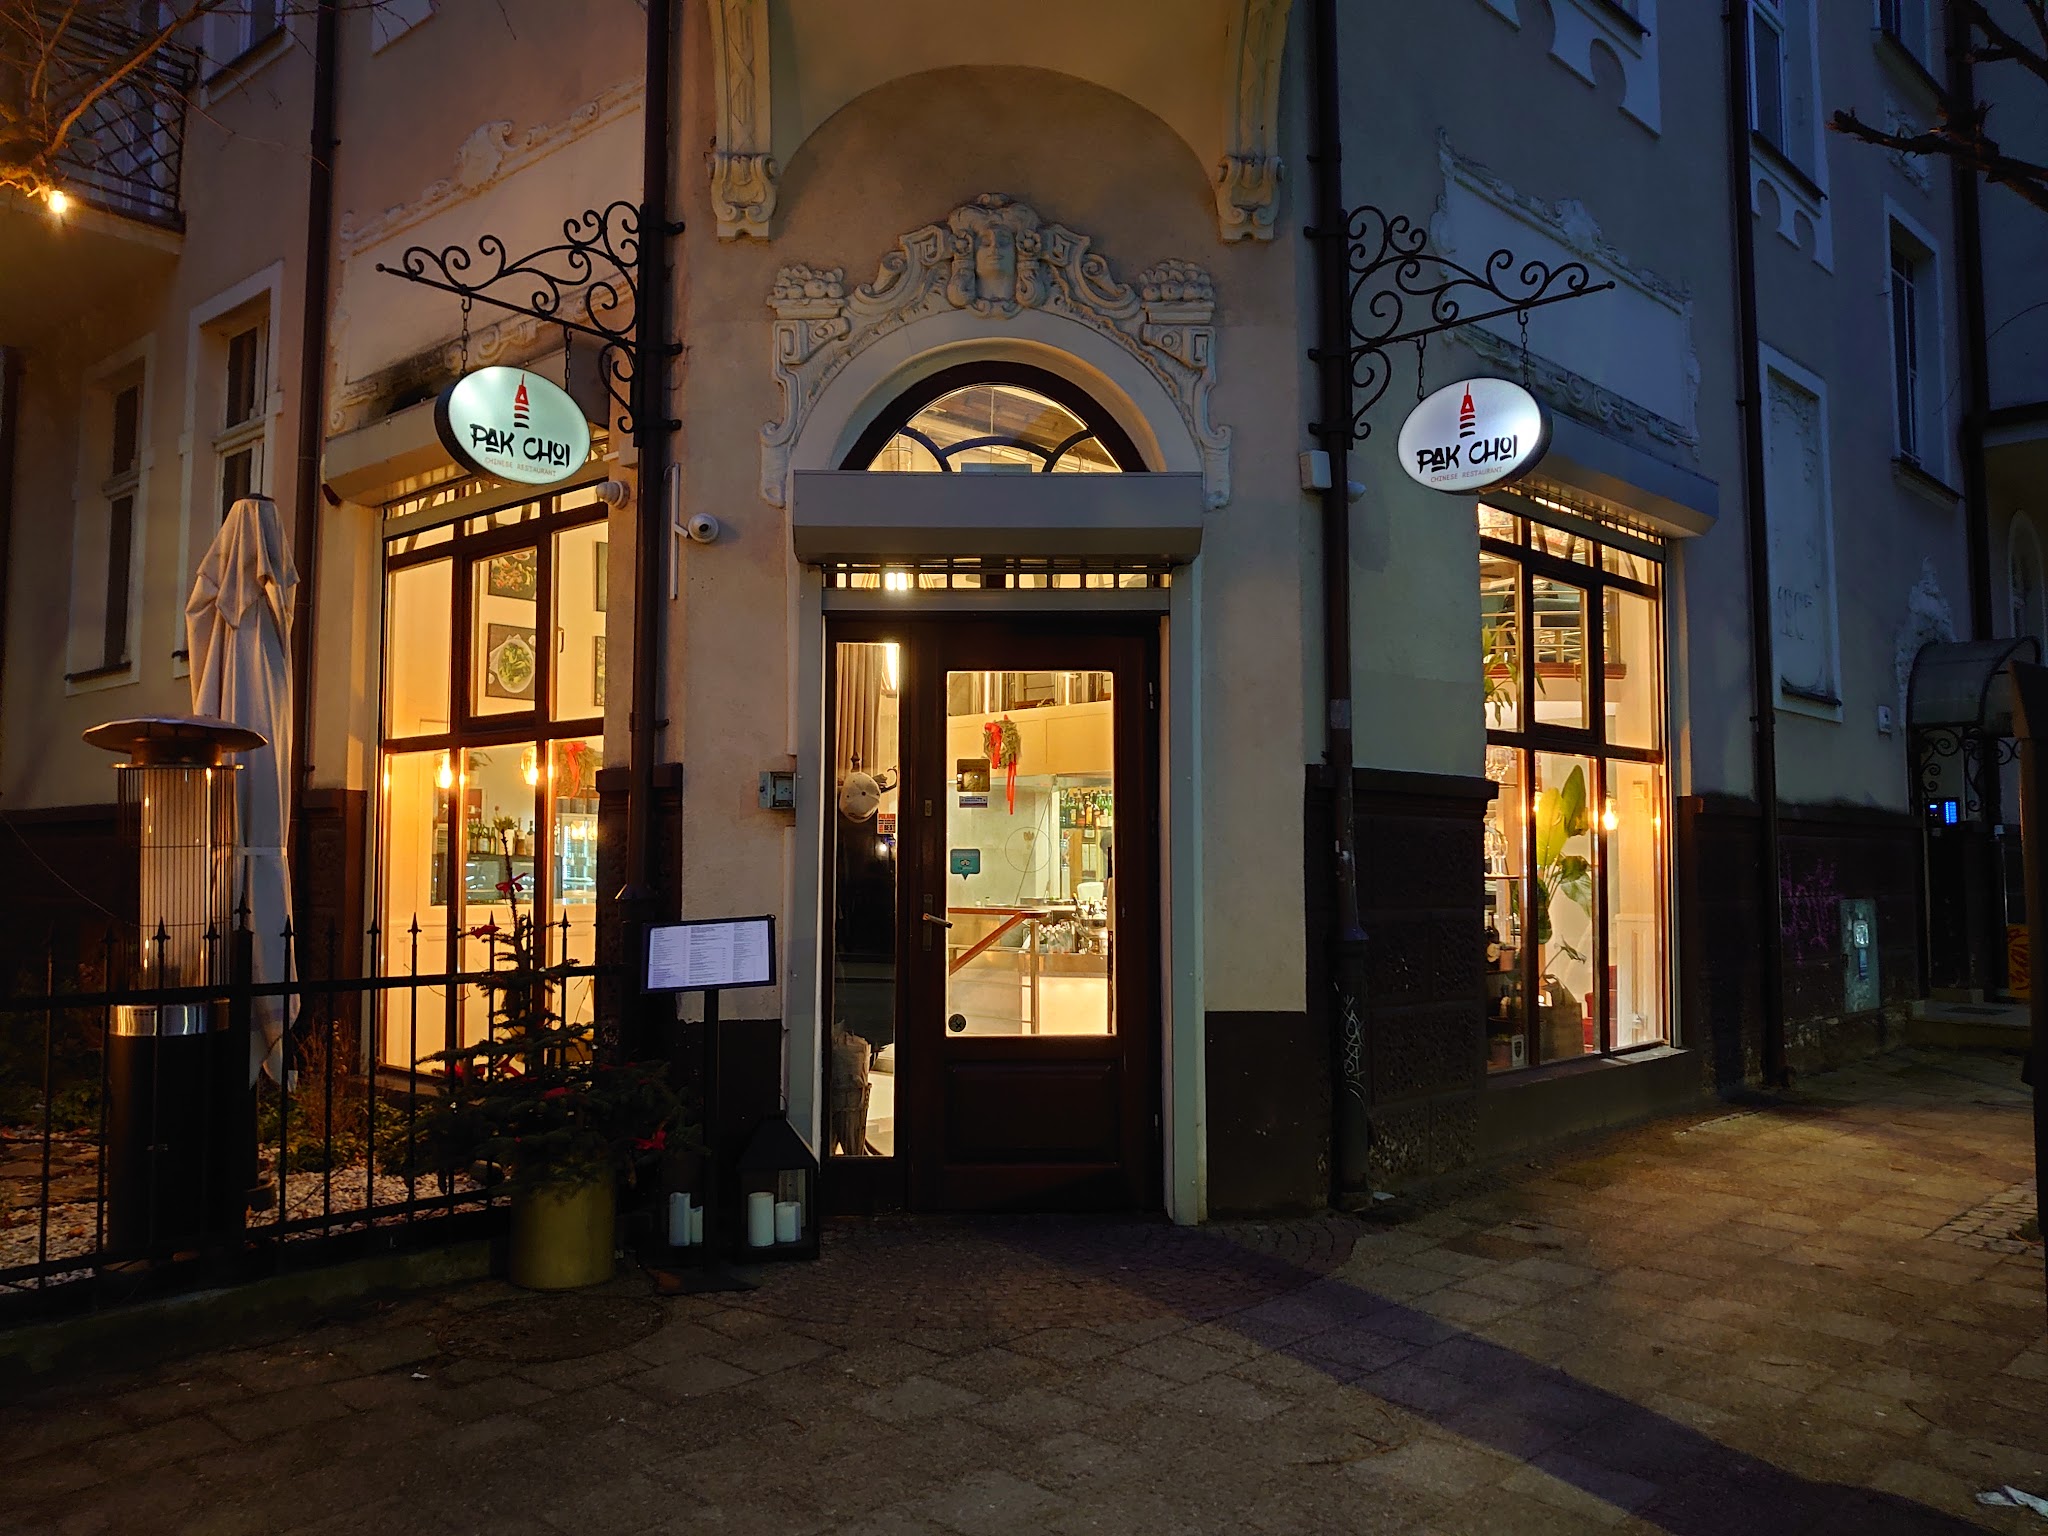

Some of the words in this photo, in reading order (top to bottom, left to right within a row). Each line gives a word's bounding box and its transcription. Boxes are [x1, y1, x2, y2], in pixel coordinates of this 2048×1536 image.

[470, 424, 514, 457] PAK
[523, 437, 570, 468] CHOI
[1417, 445, 1461, 474] PAK
[1469, 435, 1517, 464] CHOI
[485, 457, 513, 469] CHINESE
[517, 464, 556, 477] RESTAURANT
[1431, 473, 1458, 483] CHINESE
[1462, 467, 1503, 478] RESTAURANT
